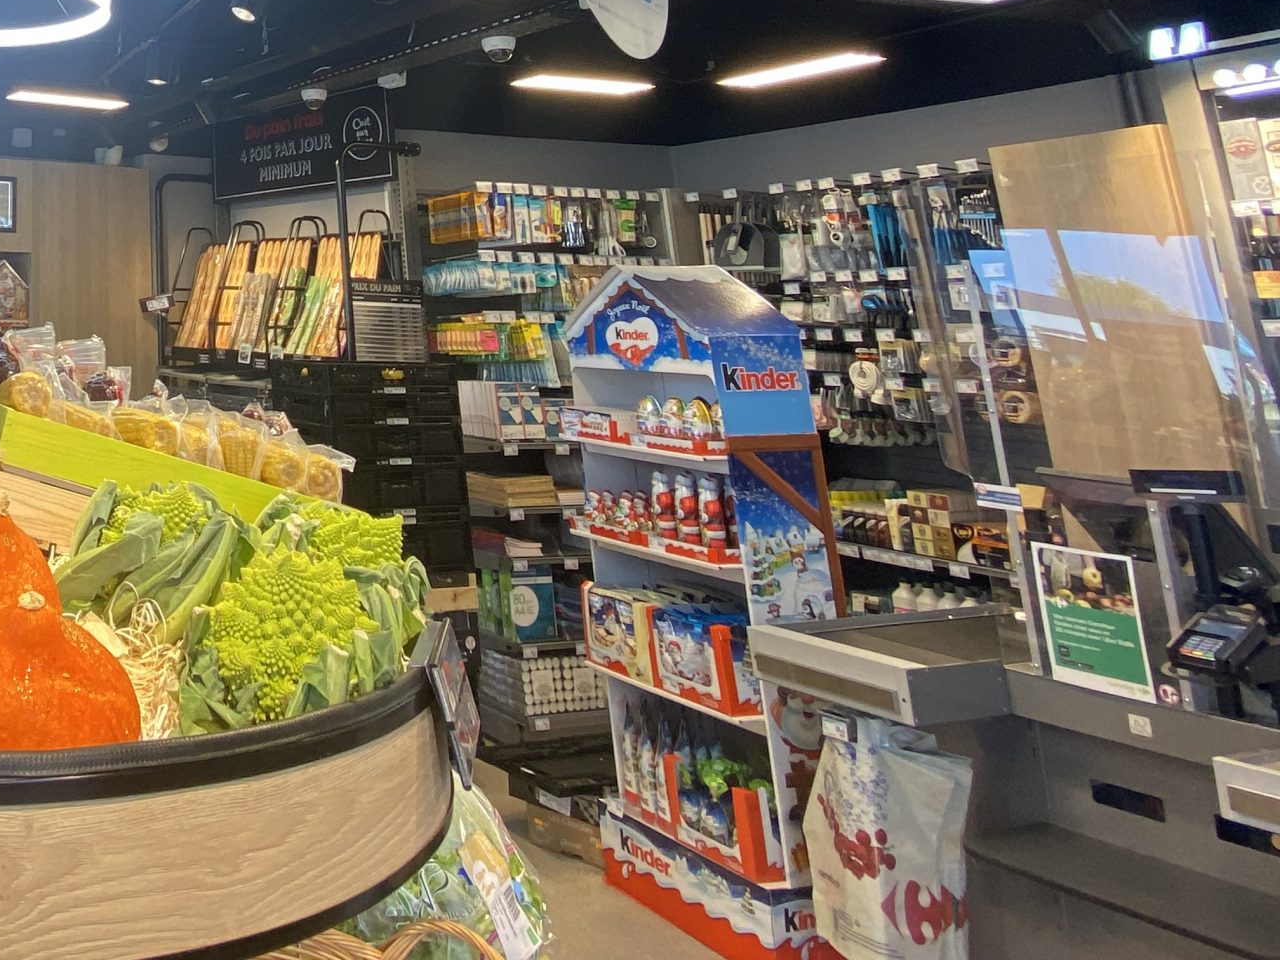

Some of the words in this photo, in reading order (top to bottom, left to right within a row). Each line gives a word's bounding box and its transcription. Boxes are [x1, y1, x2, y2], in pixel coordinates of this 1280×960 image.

[249, 141, 271, 164] FOIS
[275, 137, 297, 159] PAR
[299, 132, 333, 154] JOUR
[259, 160, 312, 182] MINIMUM
[607, 302, 630, 321] Joyeux
[631, 300, 650, 315] Noël
[784, 908, 816, 933] Kin
